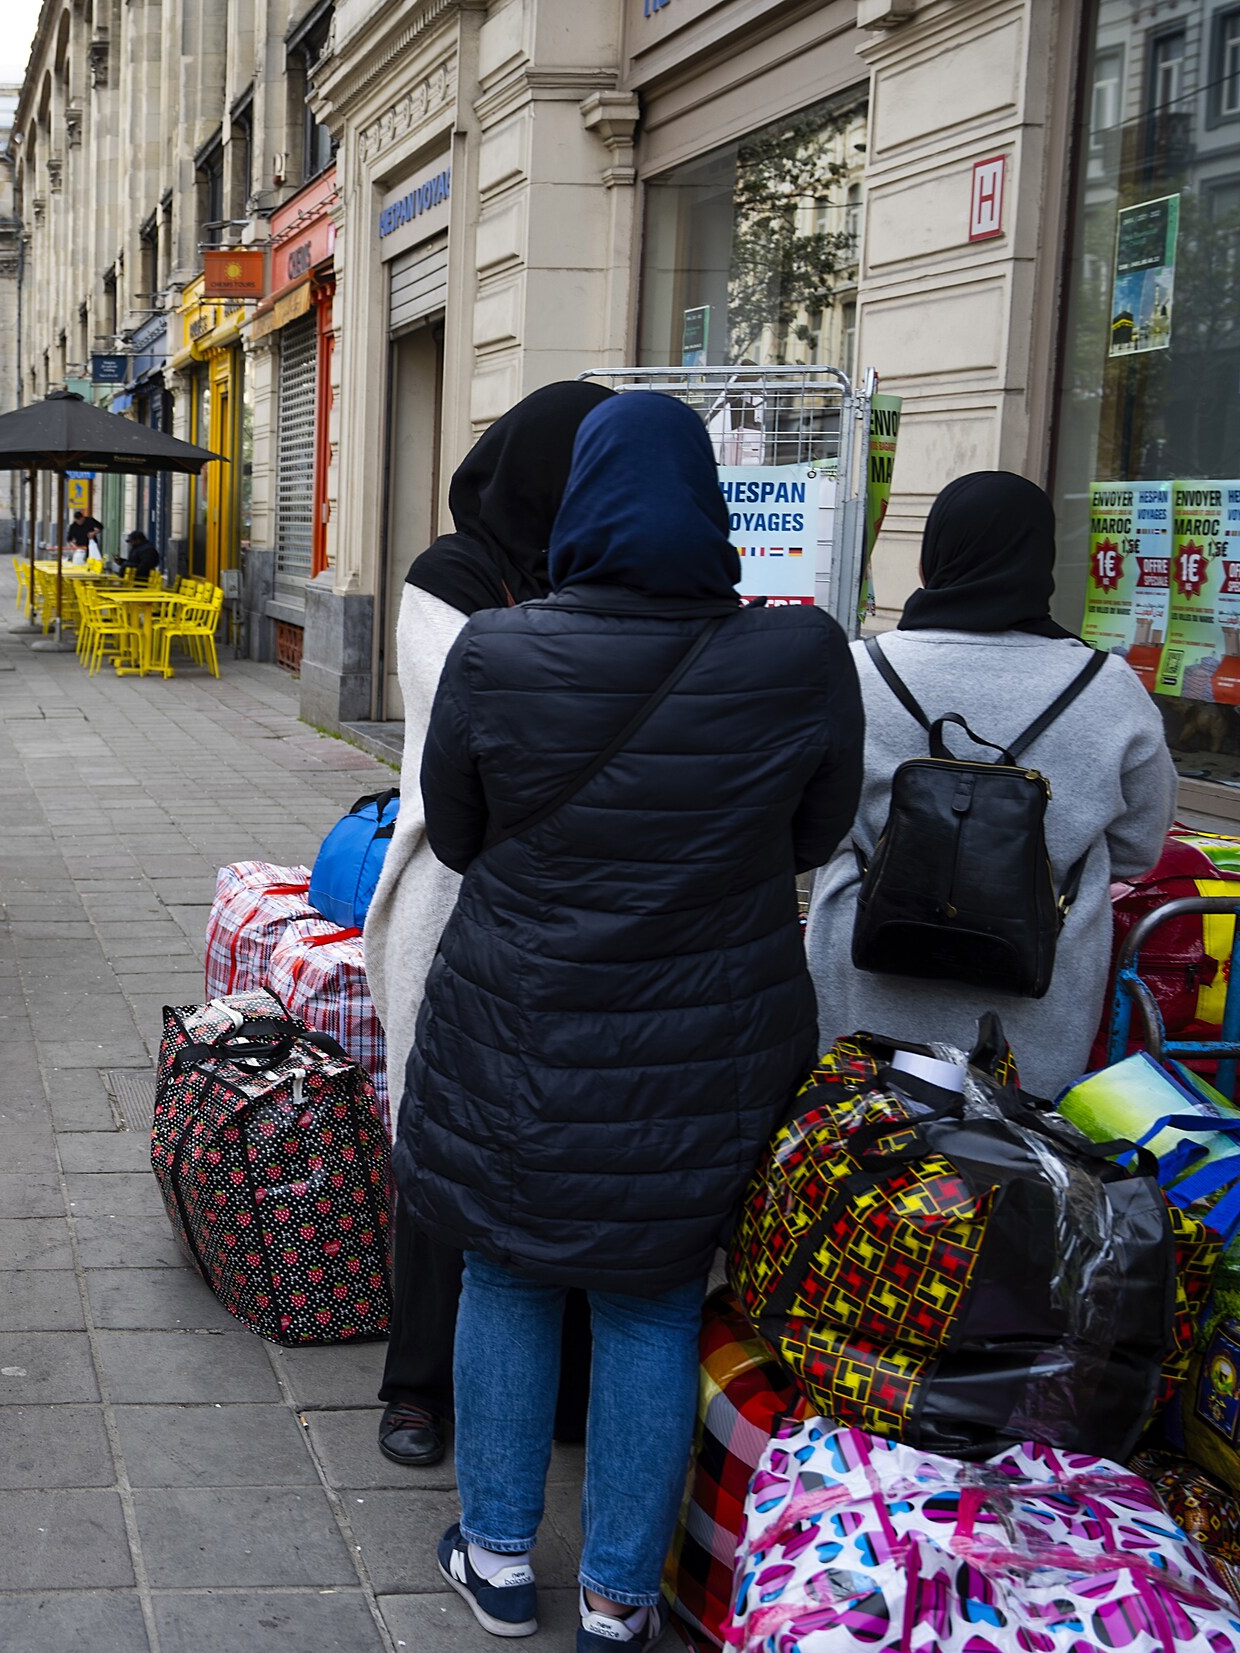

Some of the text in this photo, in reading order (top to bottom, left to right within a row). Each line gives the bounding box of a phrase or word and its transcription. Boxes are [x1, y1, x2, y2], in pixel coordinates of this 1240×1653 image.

[978, 172, 996, 224] H
[870, 409, 900, 437] ENVO
[871, 456, 895, 484] MA
[720, 482, 806, 503] HESPAN
[1092, 491, 1134, 507] ENVOYER
[1139, 490, 1168, 503] HESPAN
[1175, 490, 1222, 506] ENVOYER
[728, 513, 804, 532] OYAGES
[1137, 509, 1167, 520] VOYAGES
[1091, 518, 1132, 534] MAROC
[1174, 519, 1220, 536] MAROC
[1096, 551, 1117, 577] 1€
[1143, 559, 1168, 573] OFFRE
[1180, 554, 1201, 582] 1€
[449, 1548, 468, 1585] N
[504, 1576, 532, 1586] balance
[589, 1624, 620, 1638] balance
[597, 1621, 612, 1629] new
